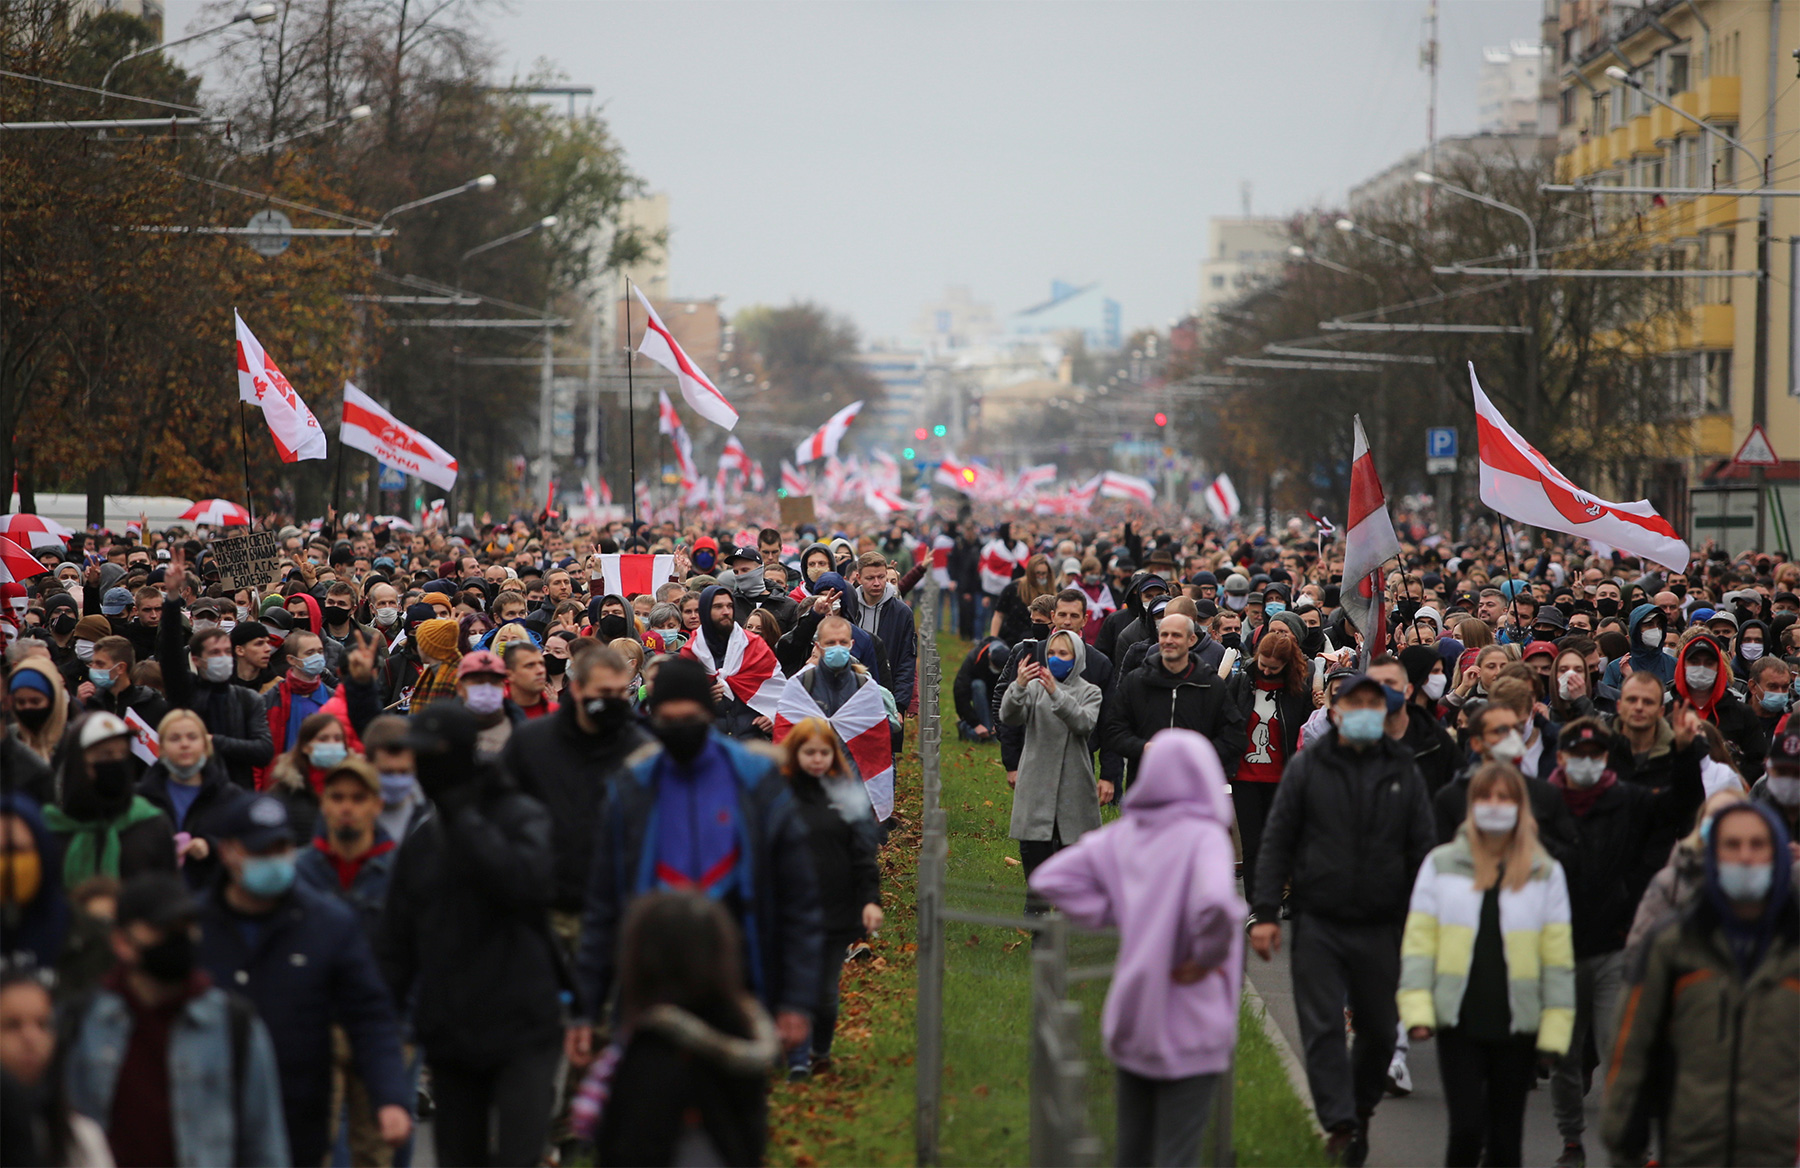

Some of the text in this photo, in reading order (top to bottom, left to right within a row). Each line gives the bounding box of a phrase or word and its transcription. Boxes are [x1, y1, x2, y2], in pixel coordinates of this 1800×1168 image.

[1433, 430, 1452, 456] P
[213, 533, 273, 553] ИМЕНЕМ СВЕТЫ
[218, 562, 251, 578] ИМЕНЕМ
[234, 573, 272, 588] БОЛЕЗНЬ
